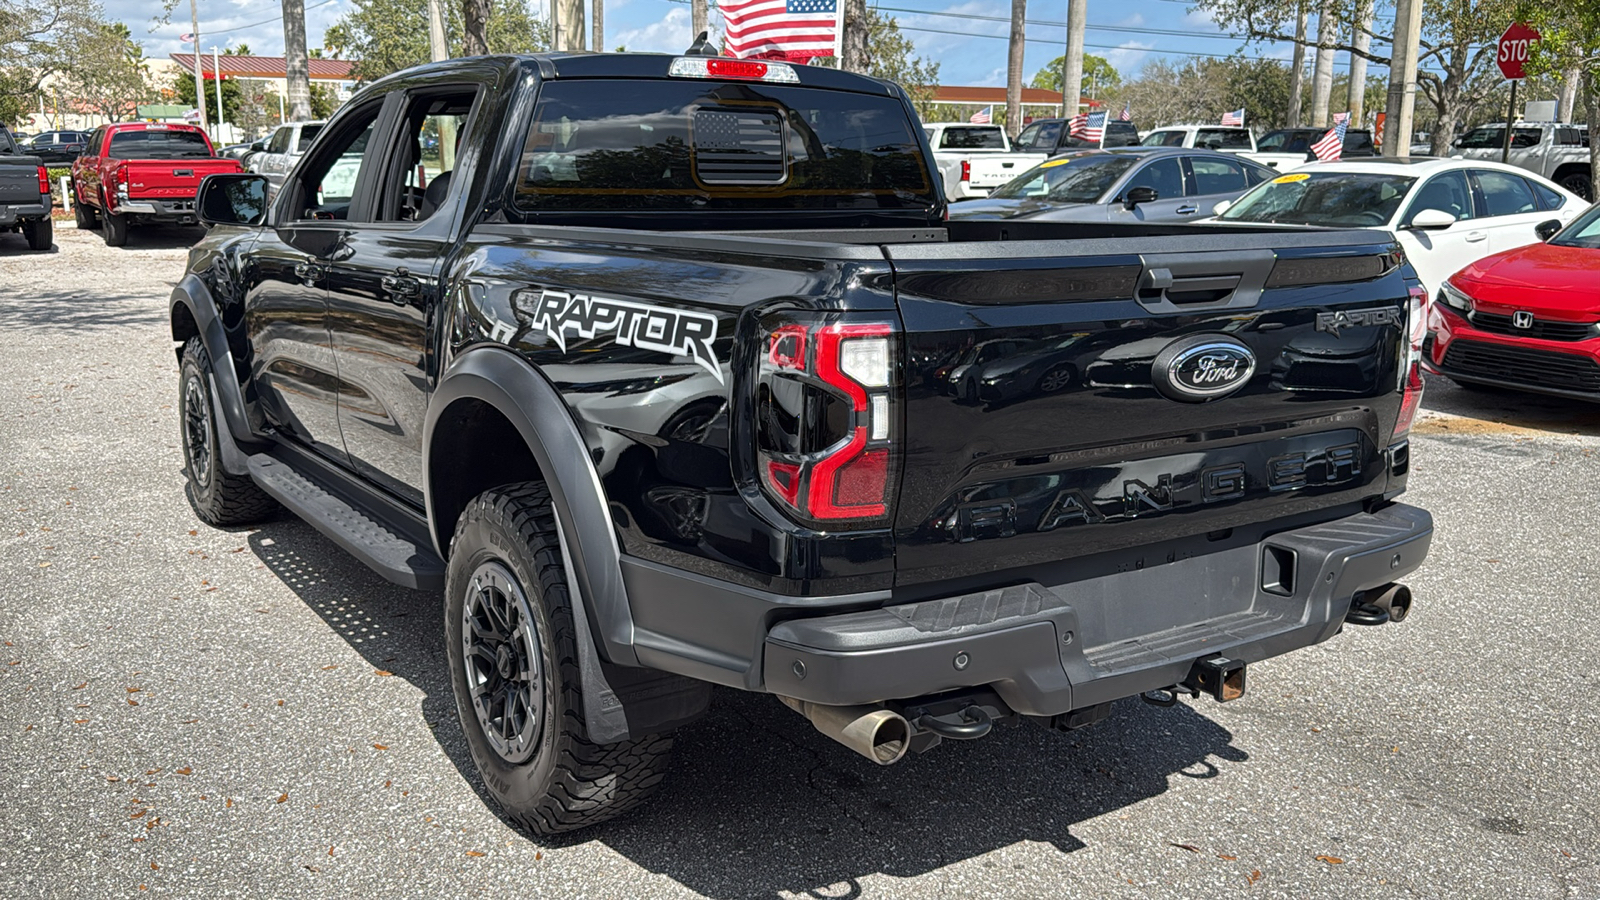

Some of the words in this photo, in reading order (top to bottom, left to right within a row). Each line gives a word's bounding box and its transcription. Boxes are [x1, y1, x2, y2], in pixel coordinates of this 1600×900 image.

[531, 290, 725, 386] RAPTOR
[1315, 305, 1403, 339] RAPTOR
[1192, 355, 1239, 384] Ford
[957, 441, 1363, 543] RANGER
